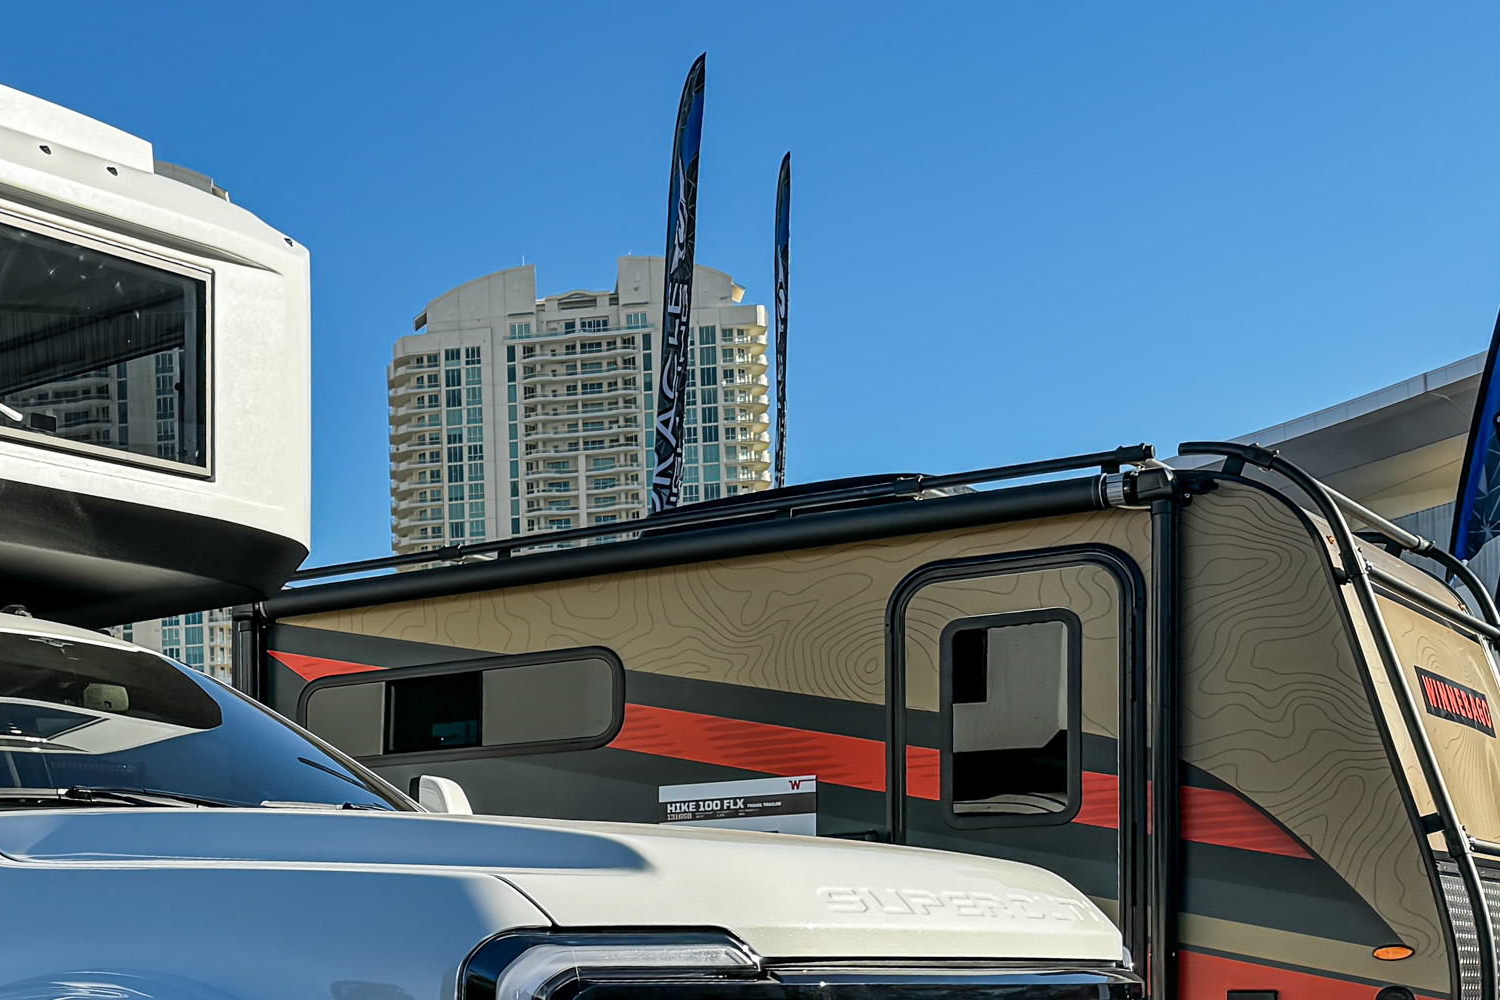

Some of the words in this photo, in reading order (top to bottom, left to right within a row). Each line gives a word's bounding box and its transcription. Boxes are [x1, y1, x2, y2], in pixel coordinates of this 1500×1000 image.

[1421, 674, 1492, 729] WINNEBAGO
[667, 802, 697, 814] HIKE
[698, 800, 721, 812] 100
[723, 798, 745, 810] FLX
[816, 886, 1016, 919] SUPER
